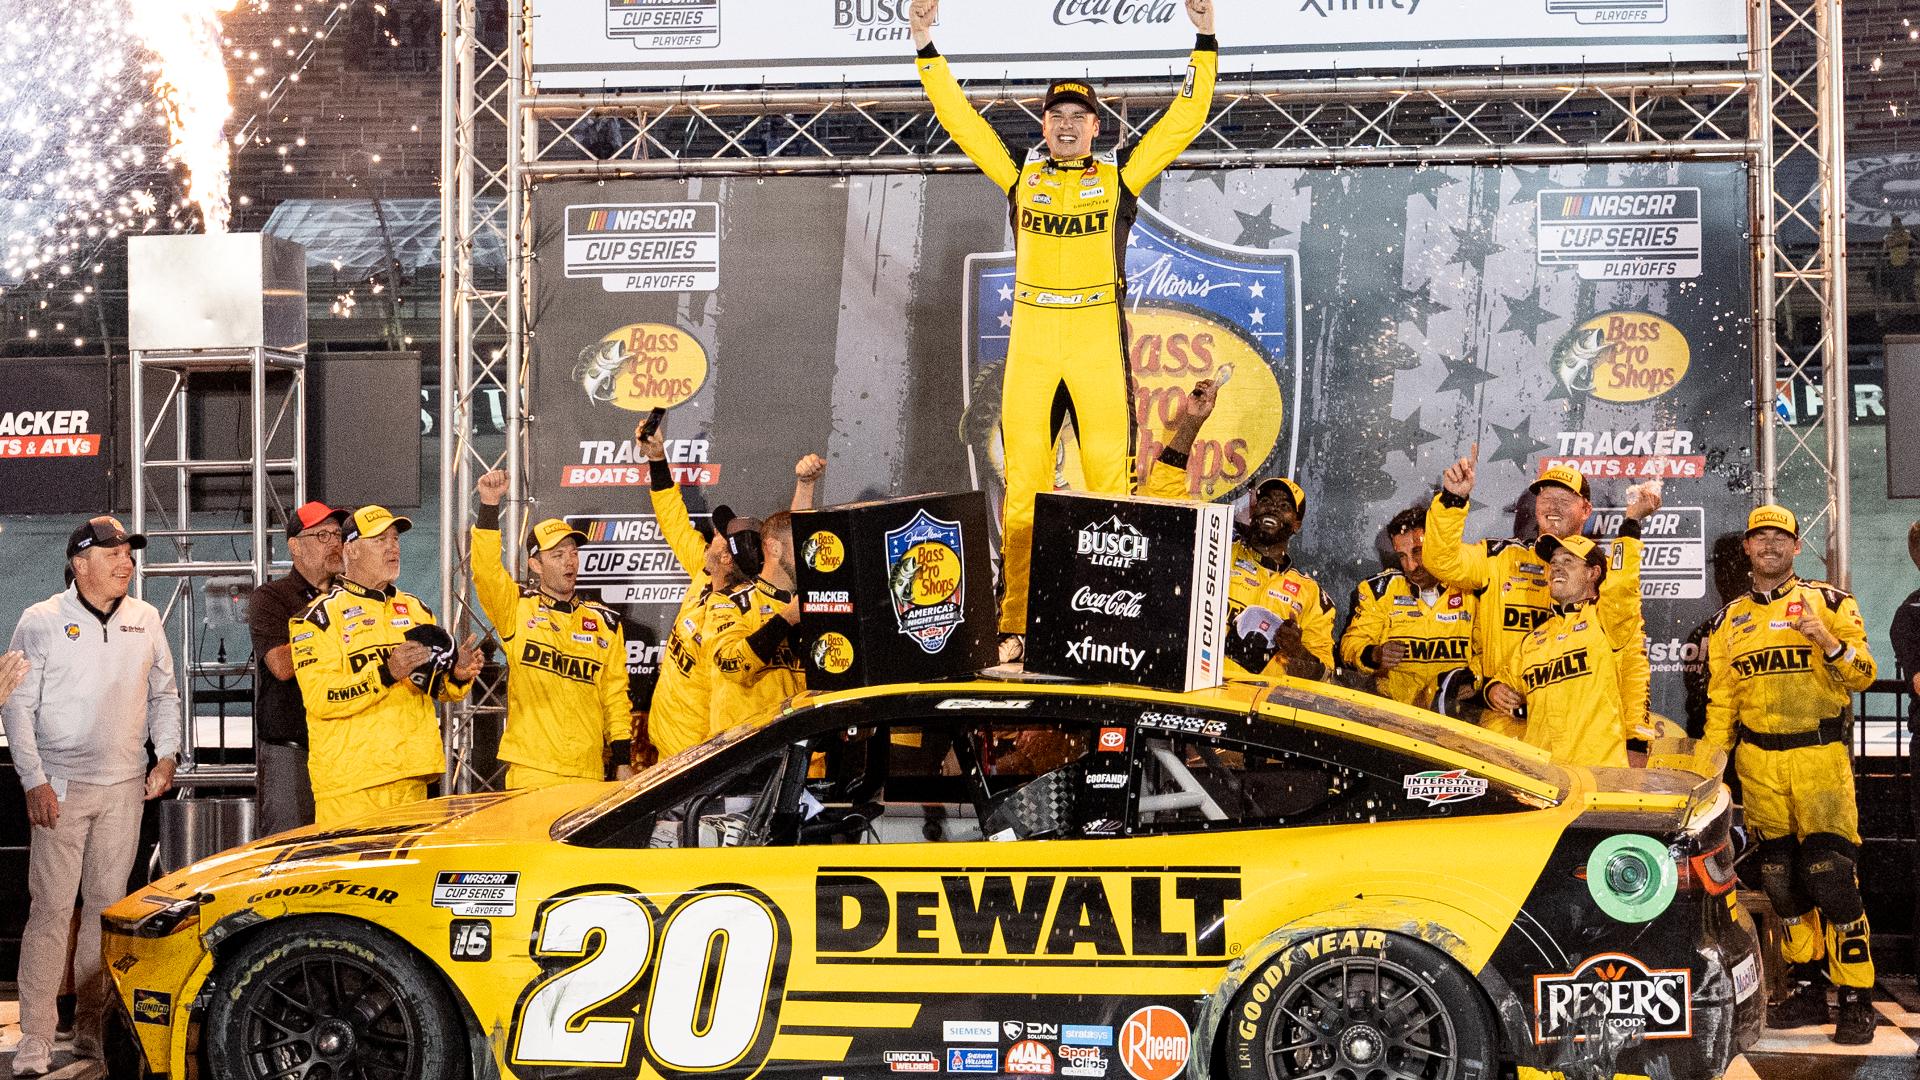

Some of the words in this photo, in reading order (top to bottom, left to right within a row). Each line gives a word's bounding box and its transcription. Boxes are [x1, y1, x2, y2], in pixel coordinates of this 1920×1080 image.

[623, 12, 652, 25] CUP
[653, 11, 704, 25] SERIES
[833, 0, 940, 29] BUSC
[1053, 0, 1176, 25] CocaCola
[1595, 11, 1648, 21] PLAYOFFS
[652, 36, 702, 46] PLAYOFFS
[1589, 194, 1677, 217] NASCAR
[613, 209, 696, 231] NASCAR
[1560, 228, 1603, 248] CUP
[1605, 227, 1678, 247] SERIES
[586, 241, 627, 261] CUP
[628, 240, 697, 260] SERIES
[1603, 261, 1677, 277] PLAYOFFS
[626, 275, 695, 289] PLAYOFFS
[1606, 316, 1660, 342] Bass
[629, 328, 679, 353] Bass
[1130, 326, 1215, 377] ass
[1608, 341, 1649, 365] Pro
[629, 352, 669, 375] Pro
[1608, 364, 1676, 392] Shops
[629, 374, 693, 403] Shops
[1132, 376, 1190, 431] ro
[1556, 431, 1693, 456] TRACKER
[569, 468, 640, 483] BOATS
[668, 468, 711, 483] TVs
[1625, 463, 1636, 474] &
[612, 521, 695, 541] NASC
[1593, 513, 1680, 535] NACAR
[818, 533, 834, 545] Bass
[1077, 530, 1149, 561] BUSCH
[819, 545, 832, 556] Pro
[917, 547, 944, 564] Bass
[1206, 513, 1220, 597] SERIES
[1640, 547, 1682, 566] RIES
[585, 553, 625, 572] CUP
[627, 552, 688, 571] SERIE
[820, 555, 841, 568] Shops
[919, 563, 940, 580] Pro
[625, 587, 687, 600] PLAYOFF
[921, 577, 954, 597] Shops
[808, 591, 849, 603] TRACKER
[907, 616, 933, 627] NIGHT
[934, 613, 955, 622] RACE
[1203, 601, 1216, 648] CUP
[828, 634, 843, 646] Bass
[828, 645, 841, 657] Pro
[1065, 636, 1145, 670] xfinity
[1404, 640, 1469, 660] EWALT
[830, 656, 850, 669] Shops
[1650, 662, 1704, 674] peedway
[1408, 777, 1484, 787] INTERSTATE
[1412, 786, 1481, 795] BATTERIES
[462, 874, 507, 884] NASCAR
[247, 880, 399, 904] GOODYEAR
[445, 889, 466, 898] CUP
[468, 888, 504, 899] SERIES
[511, 890, 780, 1073] 20
[136, 1002, 168, 1014] SUNOCO
[950, 1027, 992, 1036] SIEMENS
[1027, 1023, 1058, 1034] DN
[1128, 1009, 1187, 1071] Rheem
[886, 1053, 930, 1062] LINCOLN
[1012, 1043, 1051, 1064] MAC
[1060, 1046, 1099, 1059] Sport
[896, 1062, 934, 1071] WELDERS
[1009, 1063, 1051, 1073] TOOLS
[1073, 1057, 1106, 1069] Clips
